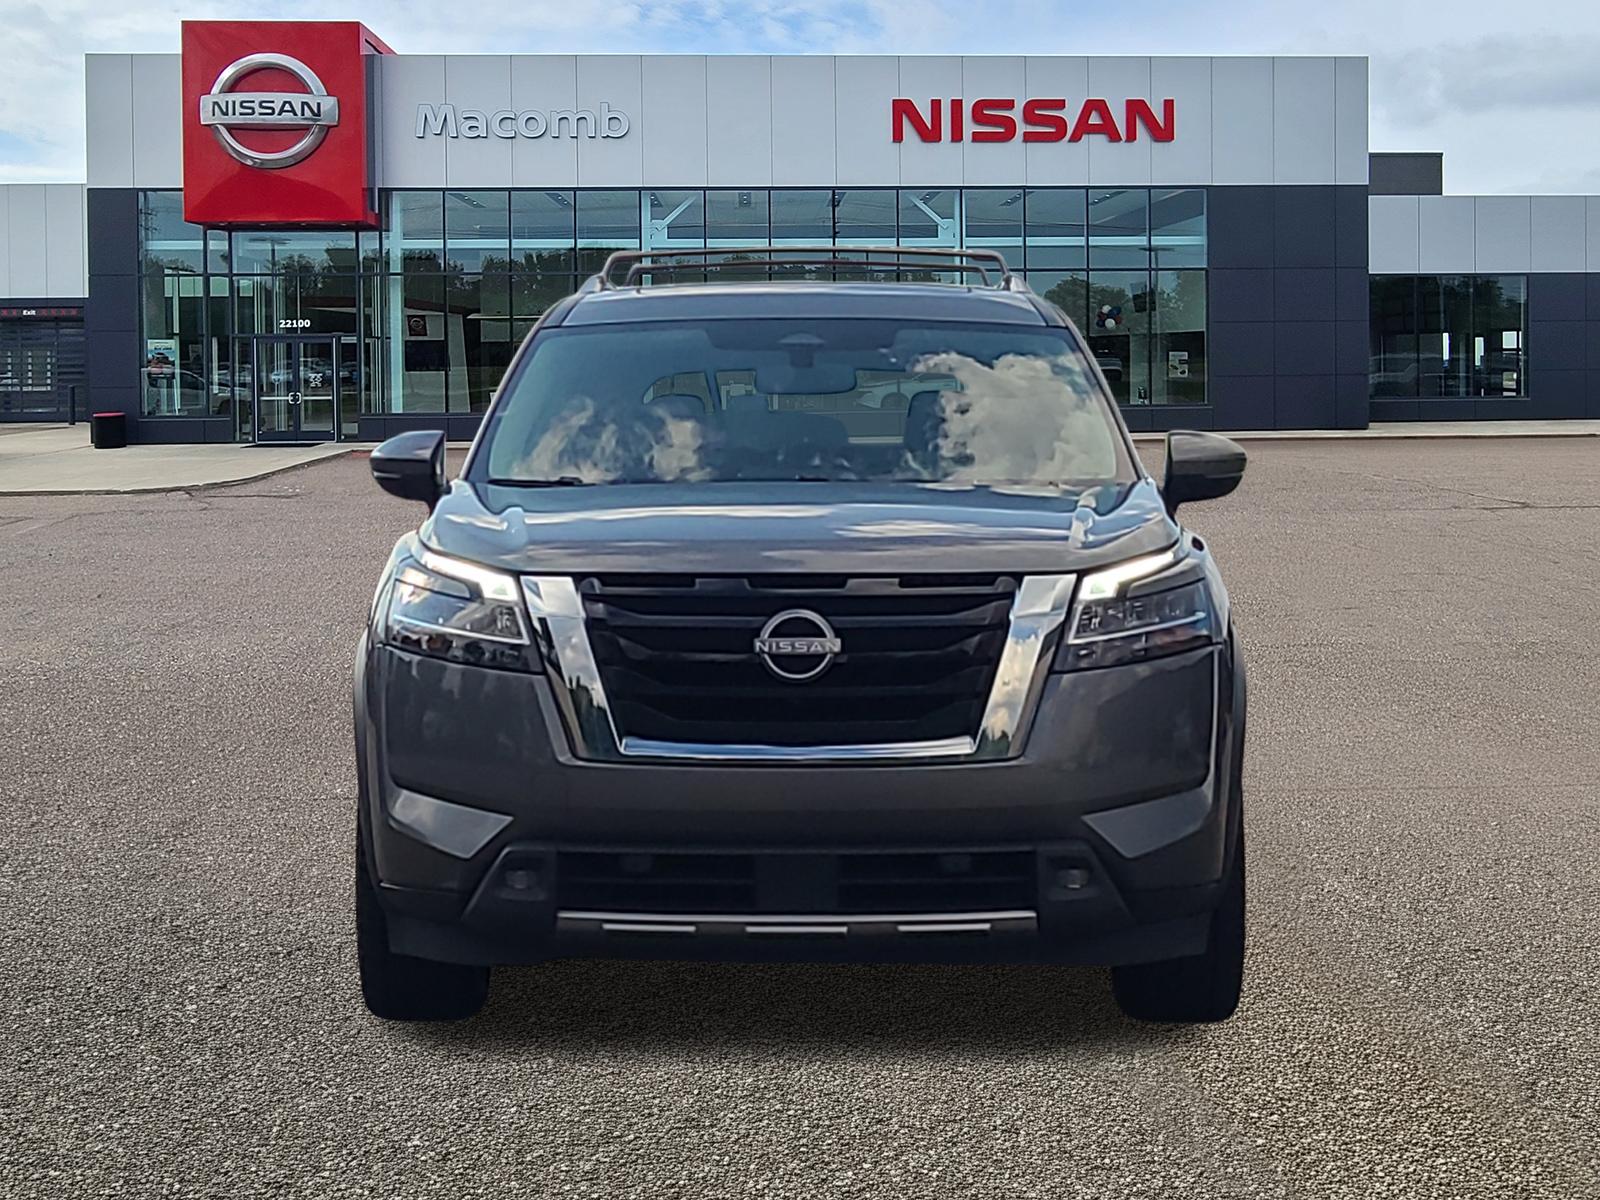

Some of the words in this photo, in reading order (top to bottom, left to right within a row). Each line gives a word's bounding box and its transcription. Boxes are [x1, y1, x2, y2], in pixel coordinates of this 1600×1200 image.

[212, 100, 322, 117] NISSAN
[415, 102, 630, 139] Macomb
[891, 98, 1175, 143] NISSAN
[279, 319, 311, 328] 22100
[755, 641, 840, 653] NISSAN
